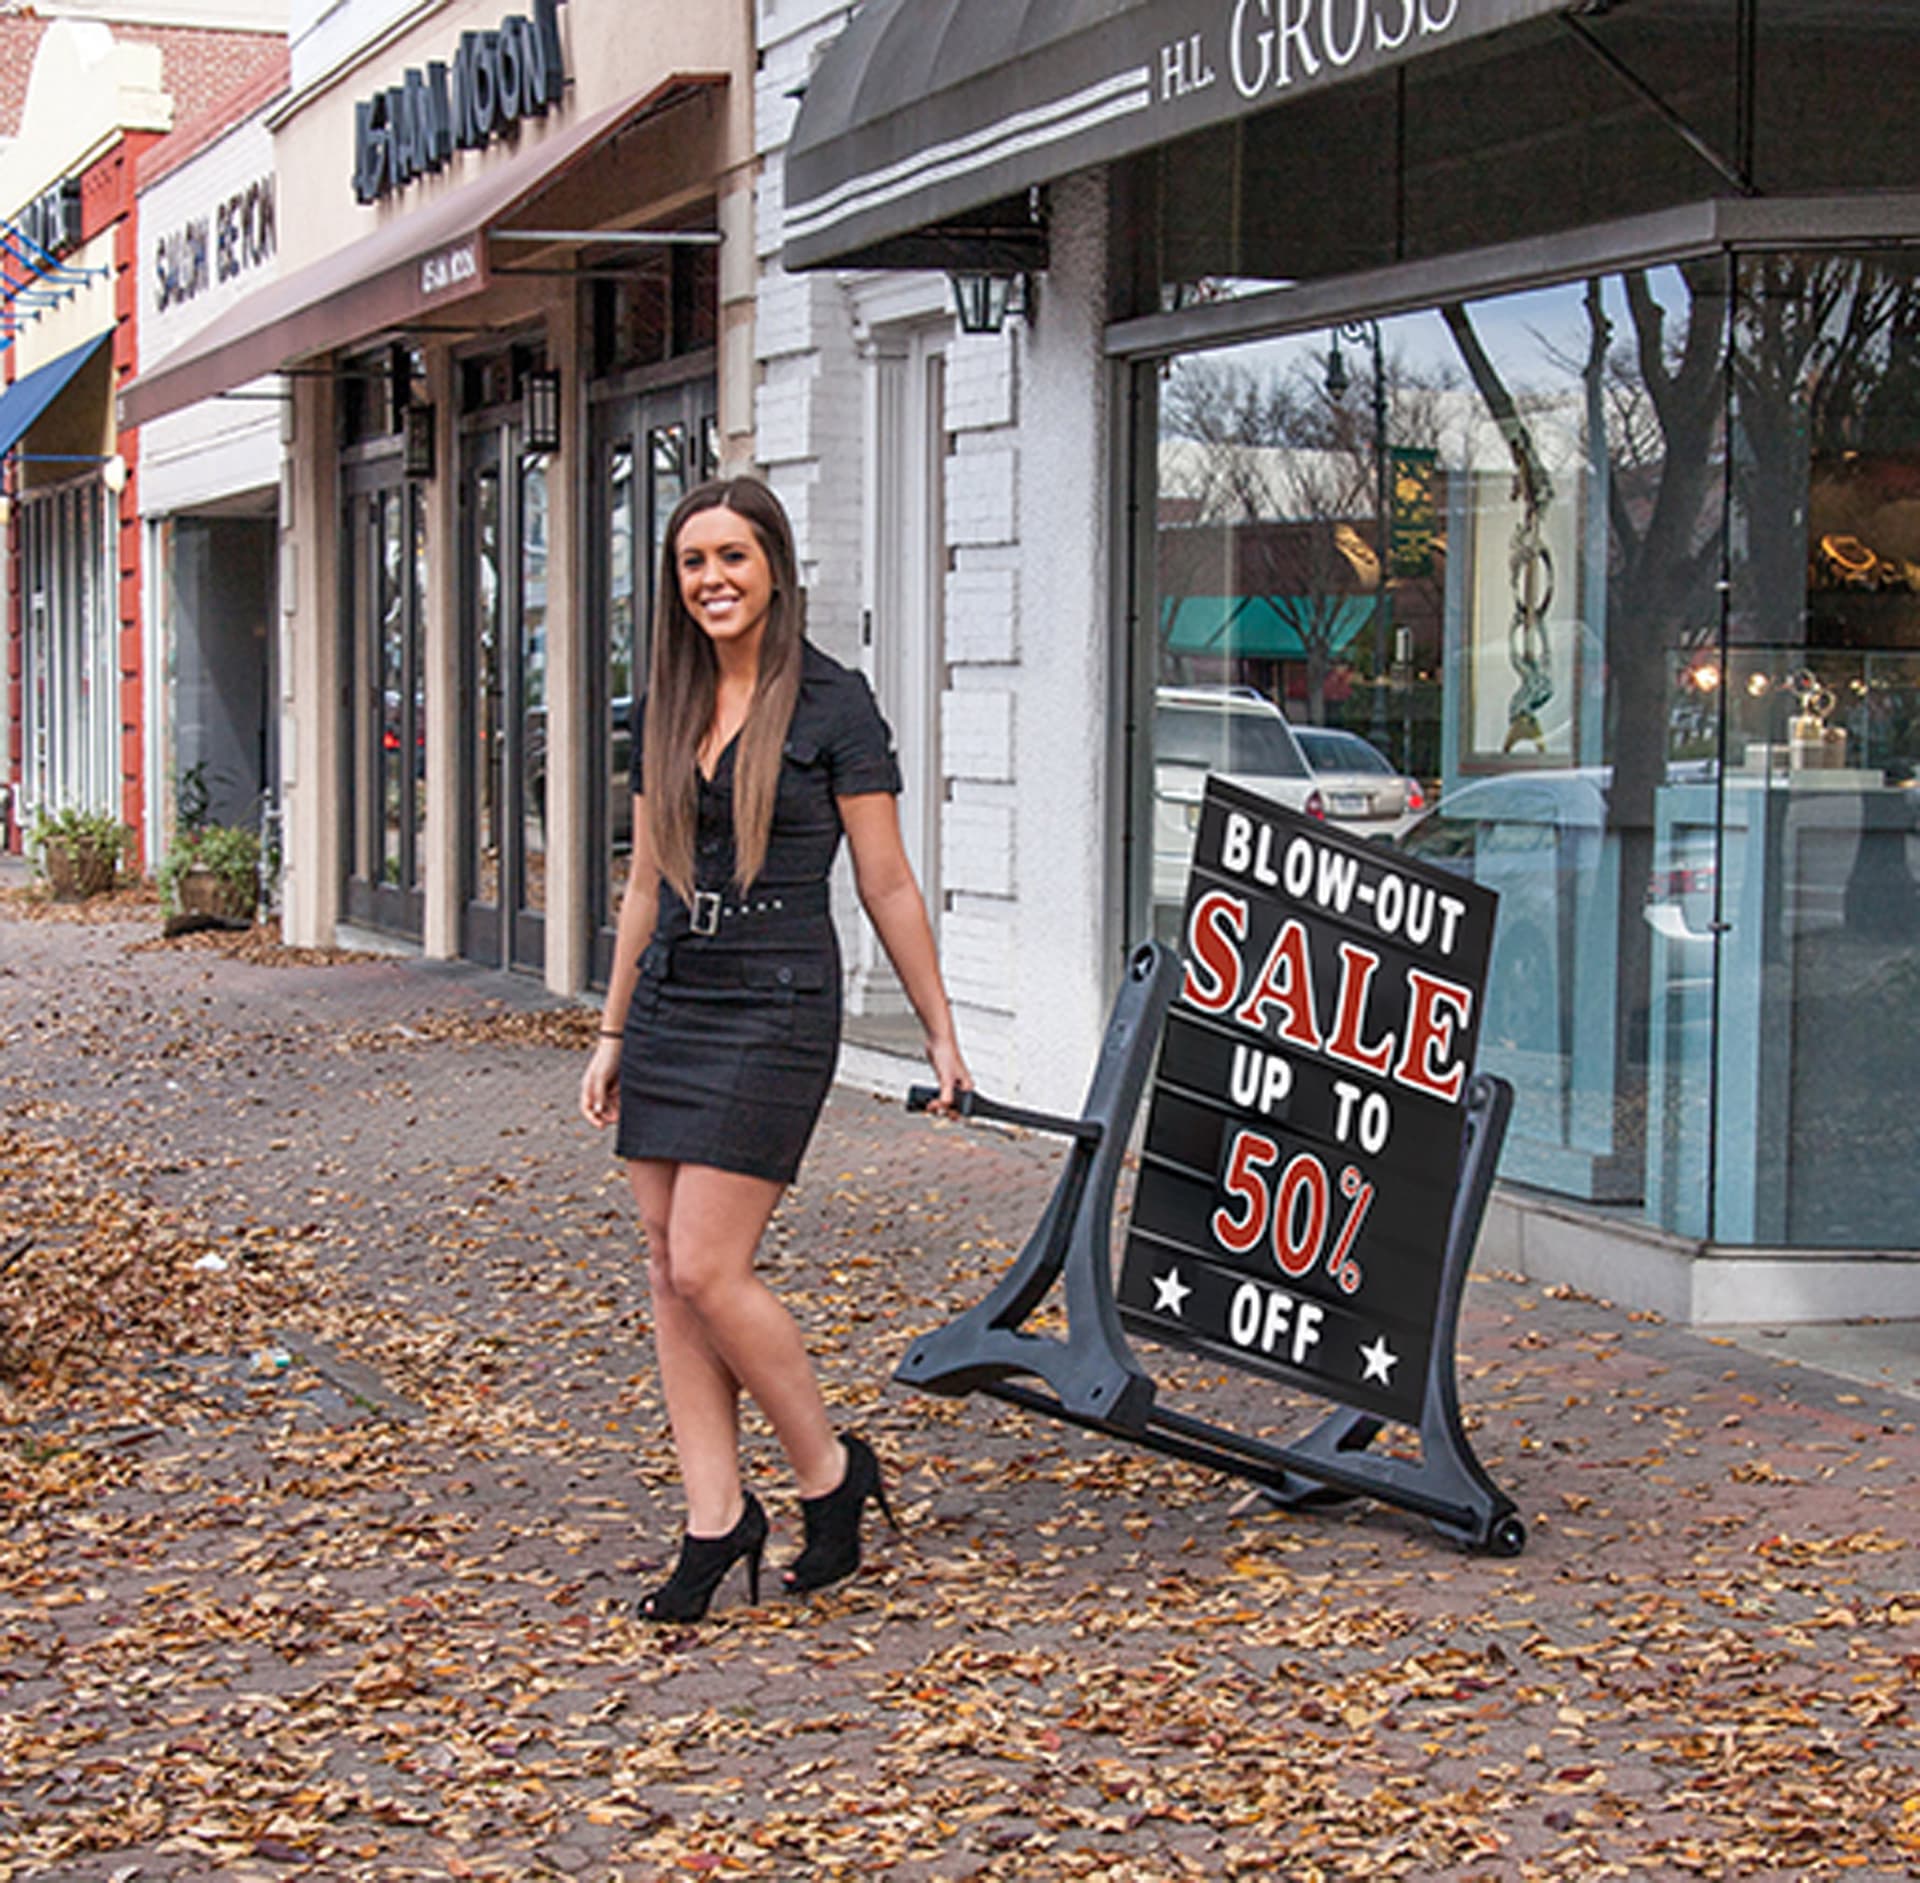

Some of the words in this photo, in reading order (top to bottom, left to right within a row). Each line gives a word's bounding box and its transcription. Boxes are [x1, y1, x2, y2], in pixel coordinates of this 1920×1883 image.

[1221, 812, 1466, 954] BLOW-OUT
[1180, 890, 1473, 1102] SALE
[1230, 1045, 1292, 1114] UP
[1333, 1080, 1389, 1153] TO
[1212, 1129, 1374, 1294] 50%
[1229, 1281, 1324, 1364] OFF
